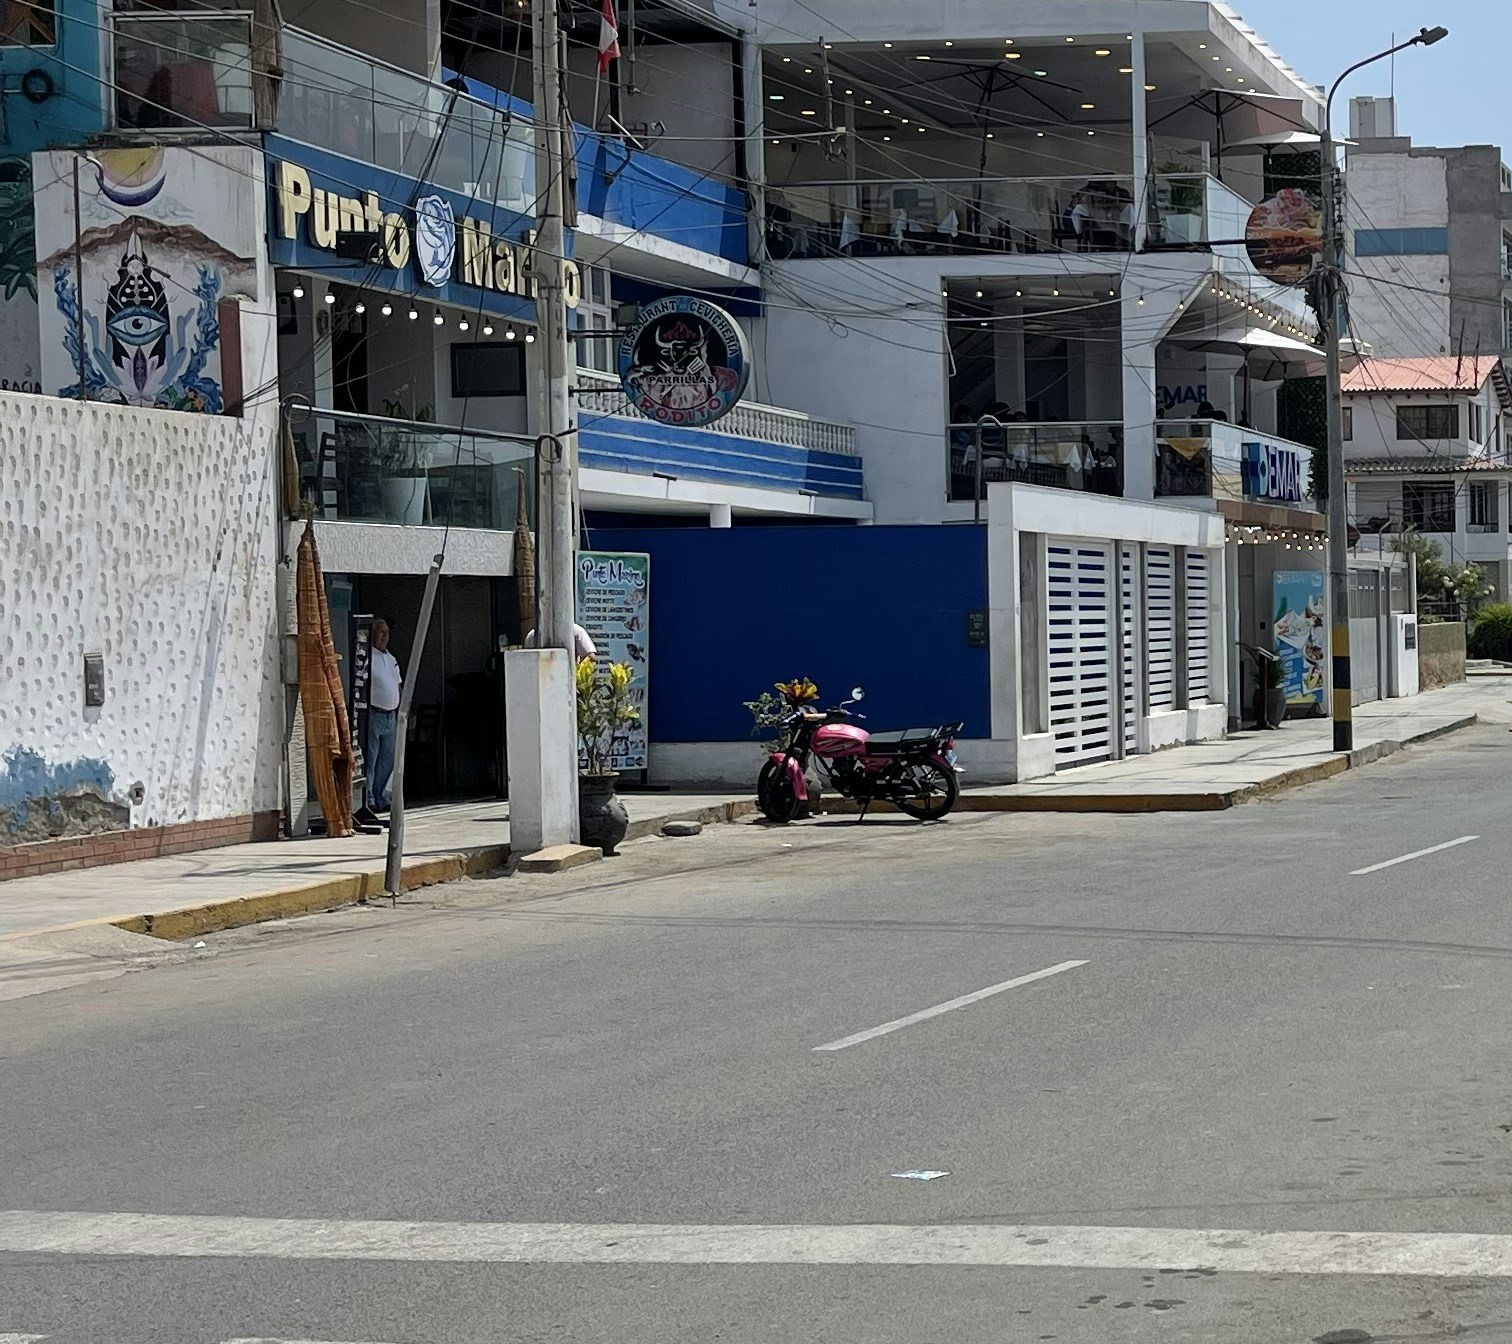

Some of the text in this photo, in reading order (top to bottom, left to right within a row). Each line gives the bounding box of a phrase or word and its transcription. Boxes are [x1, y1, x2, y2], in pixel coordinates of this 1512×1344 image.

[277, 160, 581, 309] Punto Mario
[649, 375, 715, 384] PARRILLAS
[1156, 384, 1207, 405] EMAR
[640, 397, 722, 423] RODITO
